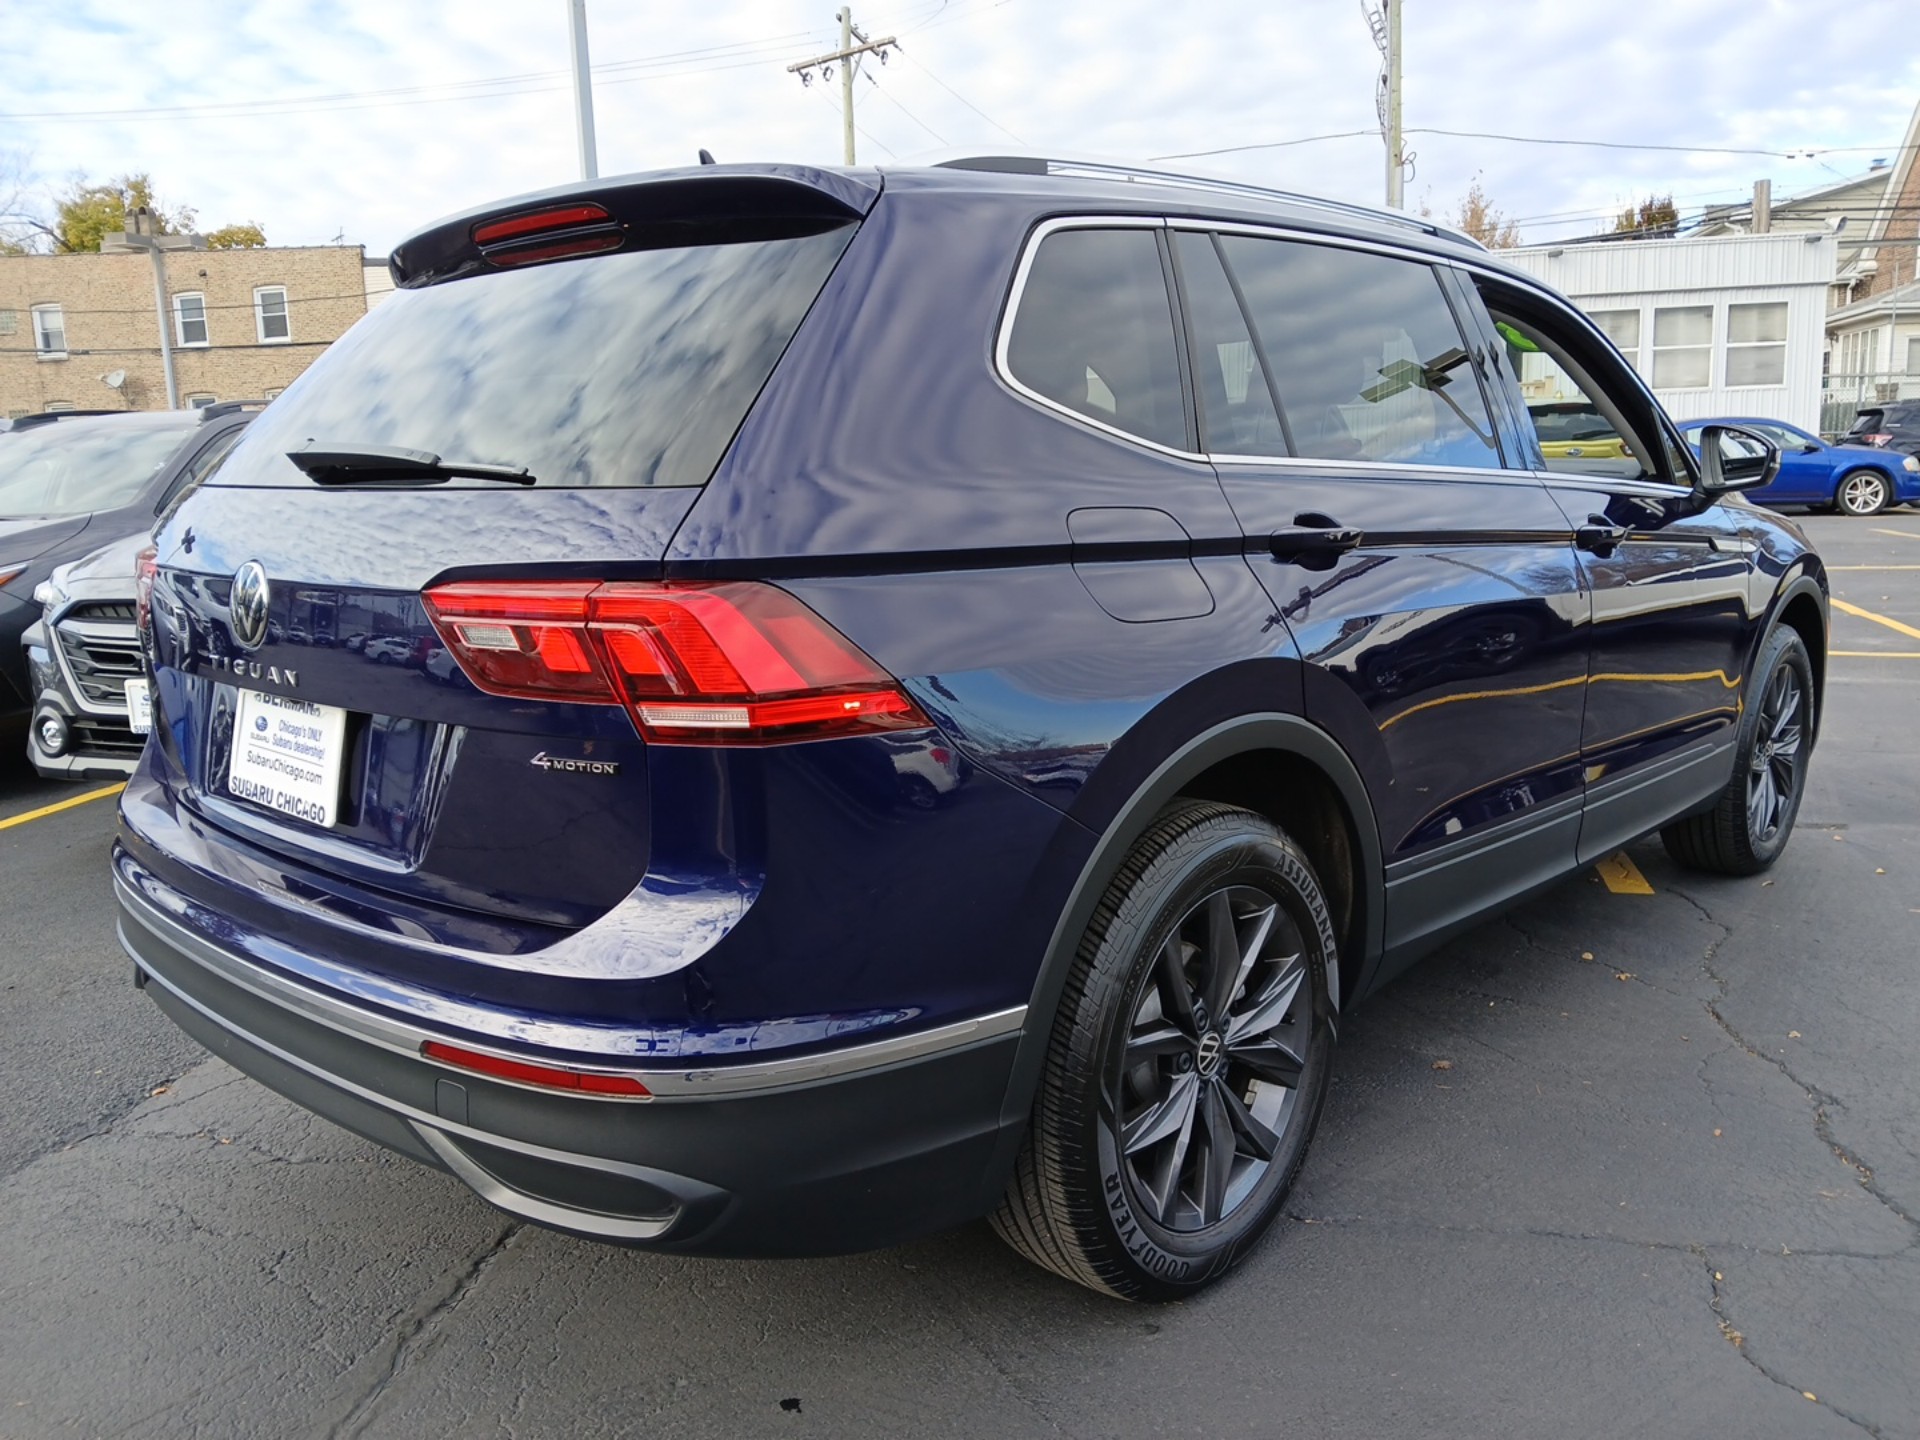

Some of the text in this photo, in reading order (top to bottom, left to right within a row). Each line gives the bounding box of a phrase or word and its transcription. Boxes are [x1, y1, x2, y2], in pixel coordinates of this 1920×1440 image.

[208, 653, 298, 688] TIGUAN
[272, 733, 293, 751] Subaru
[278, 719, 323, 743] Chicago's ONLY
[246, 750, 323, 785] SubaruChicago.com
[529, 751, 617, 775] 4MOTION
[230, 775, 326, 824] SUBARU CHICAGO
[1273, 853, 1338, 965] ASSURANCE
[1104, 1170, 1191, 1280] GOODYEAR
